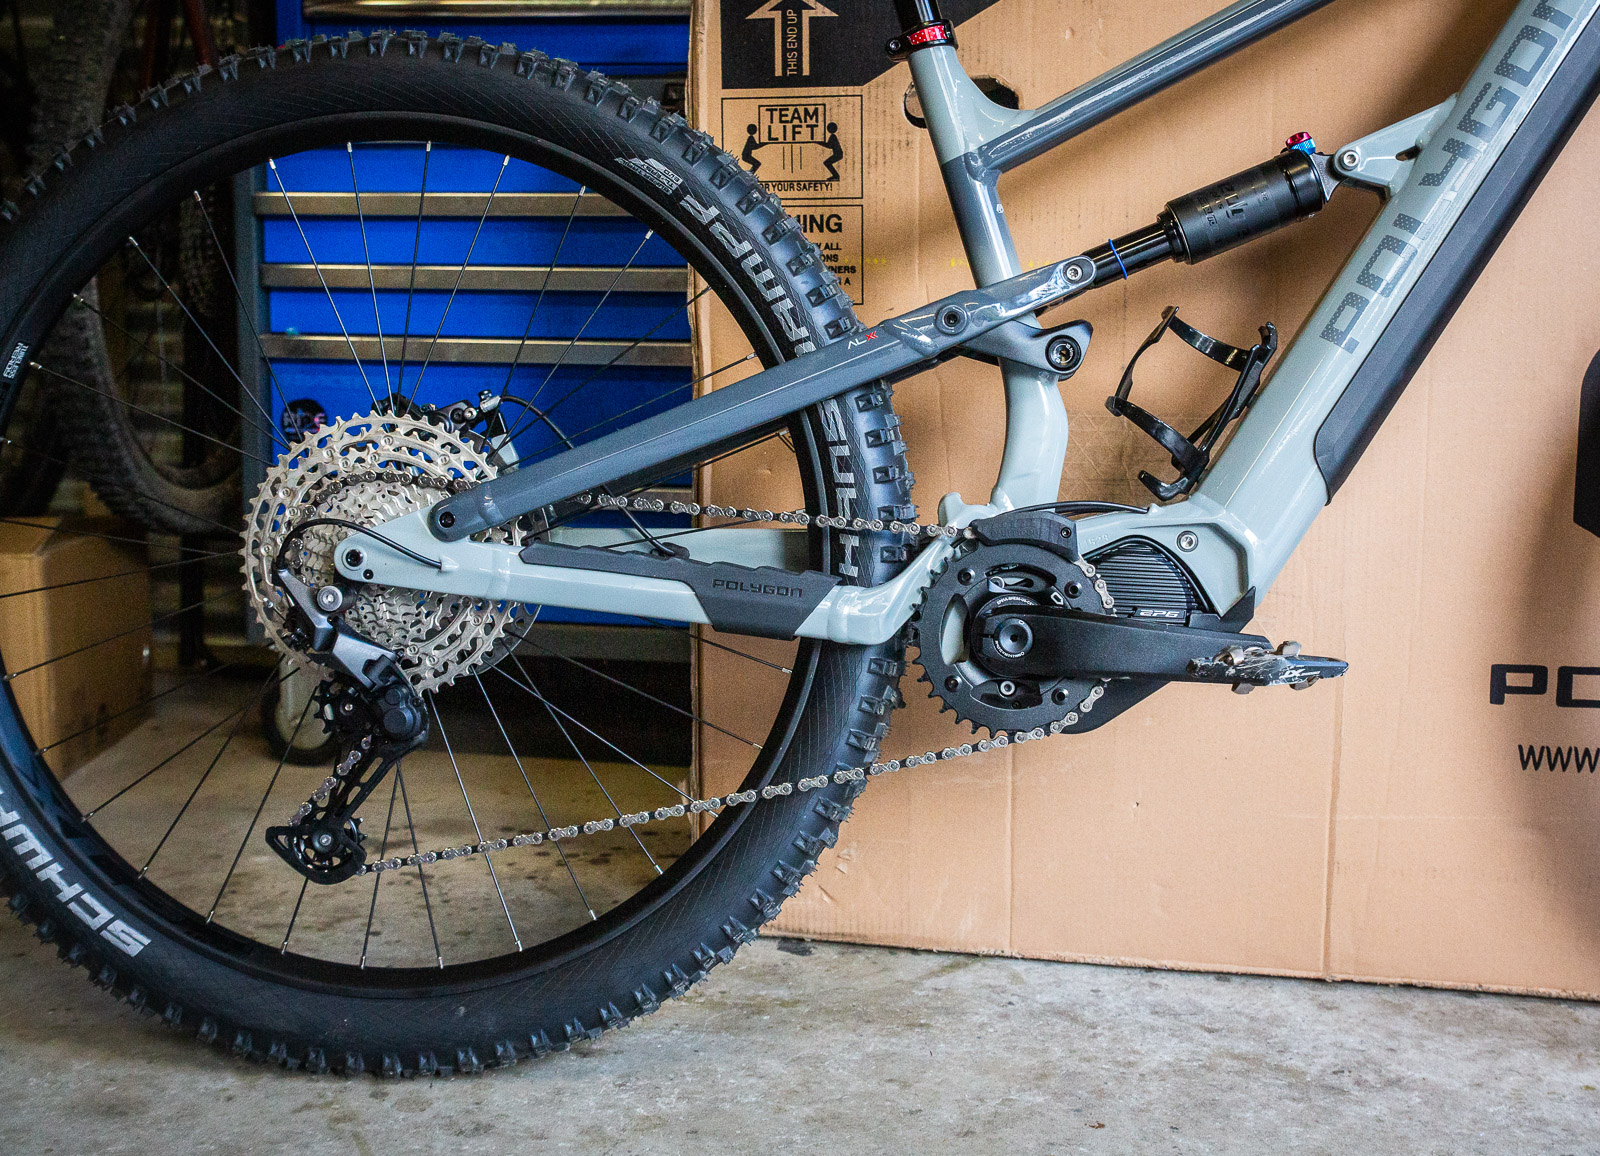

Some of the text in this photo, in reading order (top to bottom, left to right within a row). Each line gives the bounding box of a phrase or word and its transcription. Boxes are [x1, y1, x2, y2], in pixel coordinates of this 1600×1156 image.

[786, 9, 798, 76] THIS END UP
[766, 107, 820, 124] TEAM
[767, 125, 819, 141] LIFT
[771, 182, 796, 192] YOUR
[796, 182, 833, 192] SAFETY!
[823, 242, 842, 251] ALL
[713, 579, 803, 598] POLYGON
